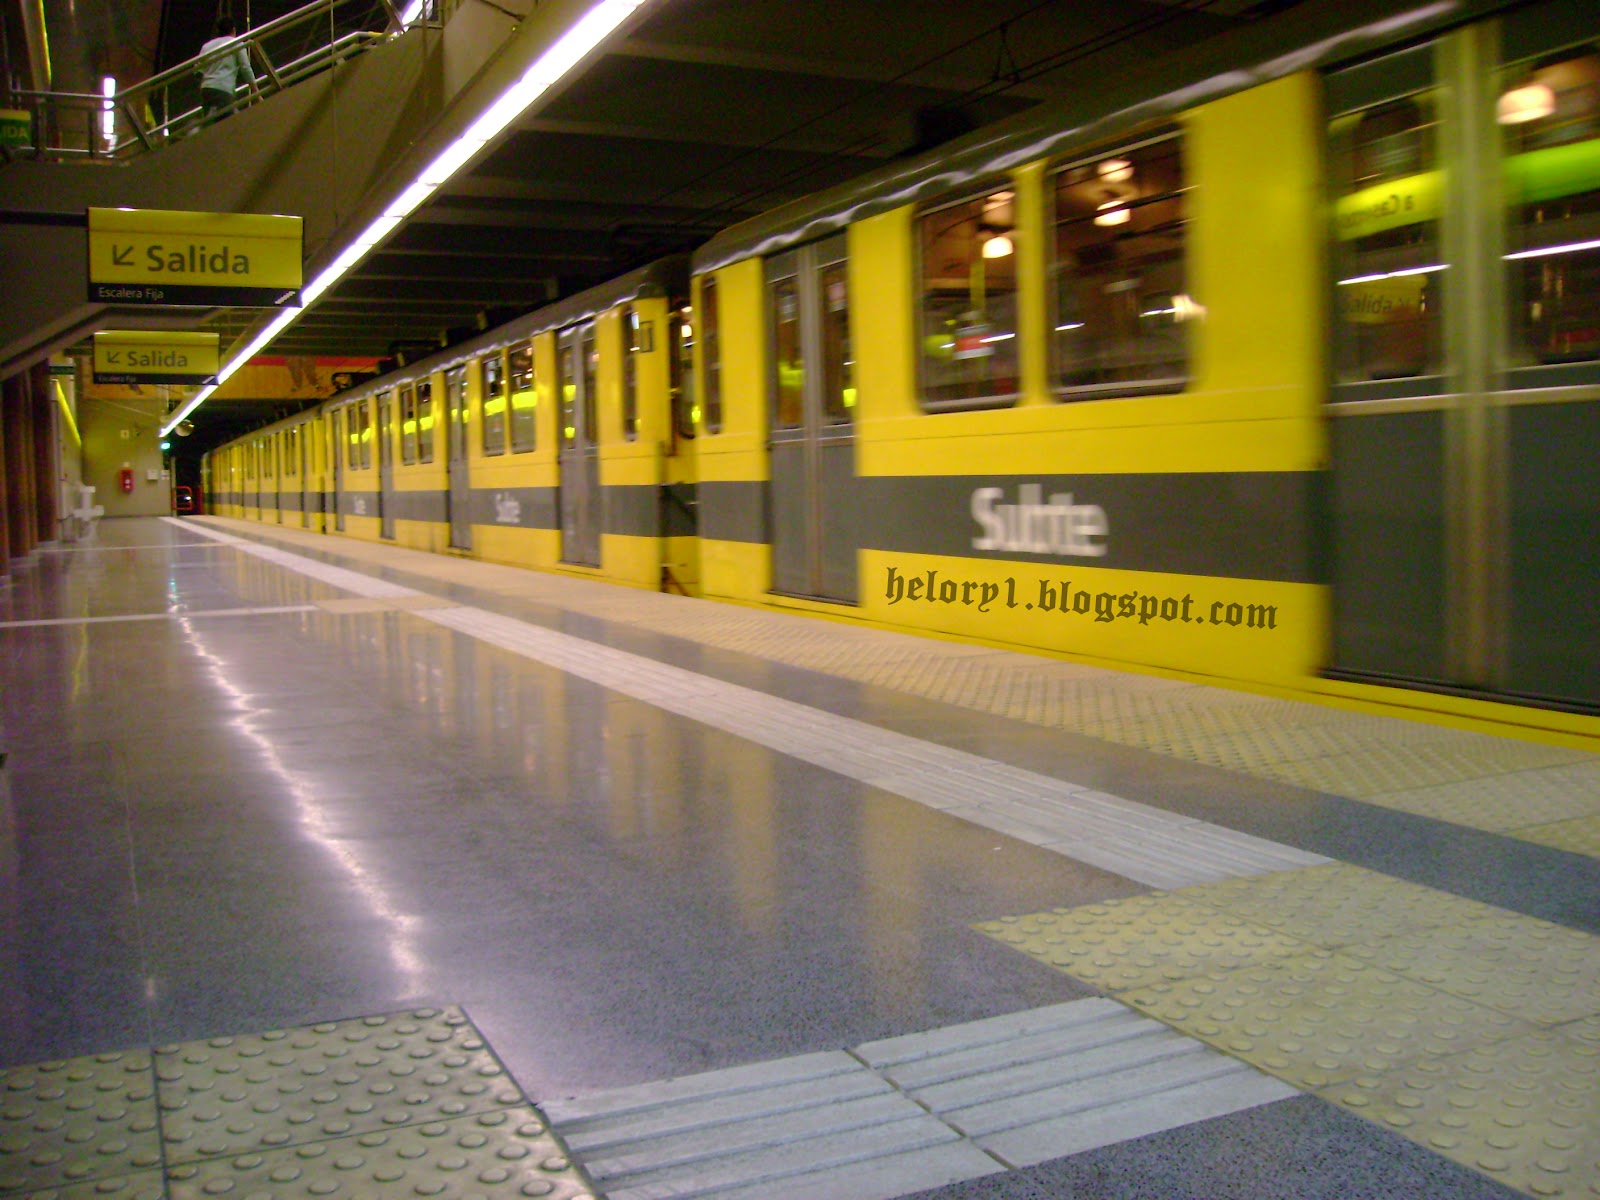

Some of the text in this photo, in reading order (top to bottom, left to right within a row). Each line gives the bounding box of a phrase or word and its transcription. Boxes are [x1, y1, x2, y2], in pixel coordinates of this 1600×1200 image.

[146, 245, 250, 275] Salida
[98, 286, 165, 301] Escalera Fija
[127, 350, 189, 367] Salida
